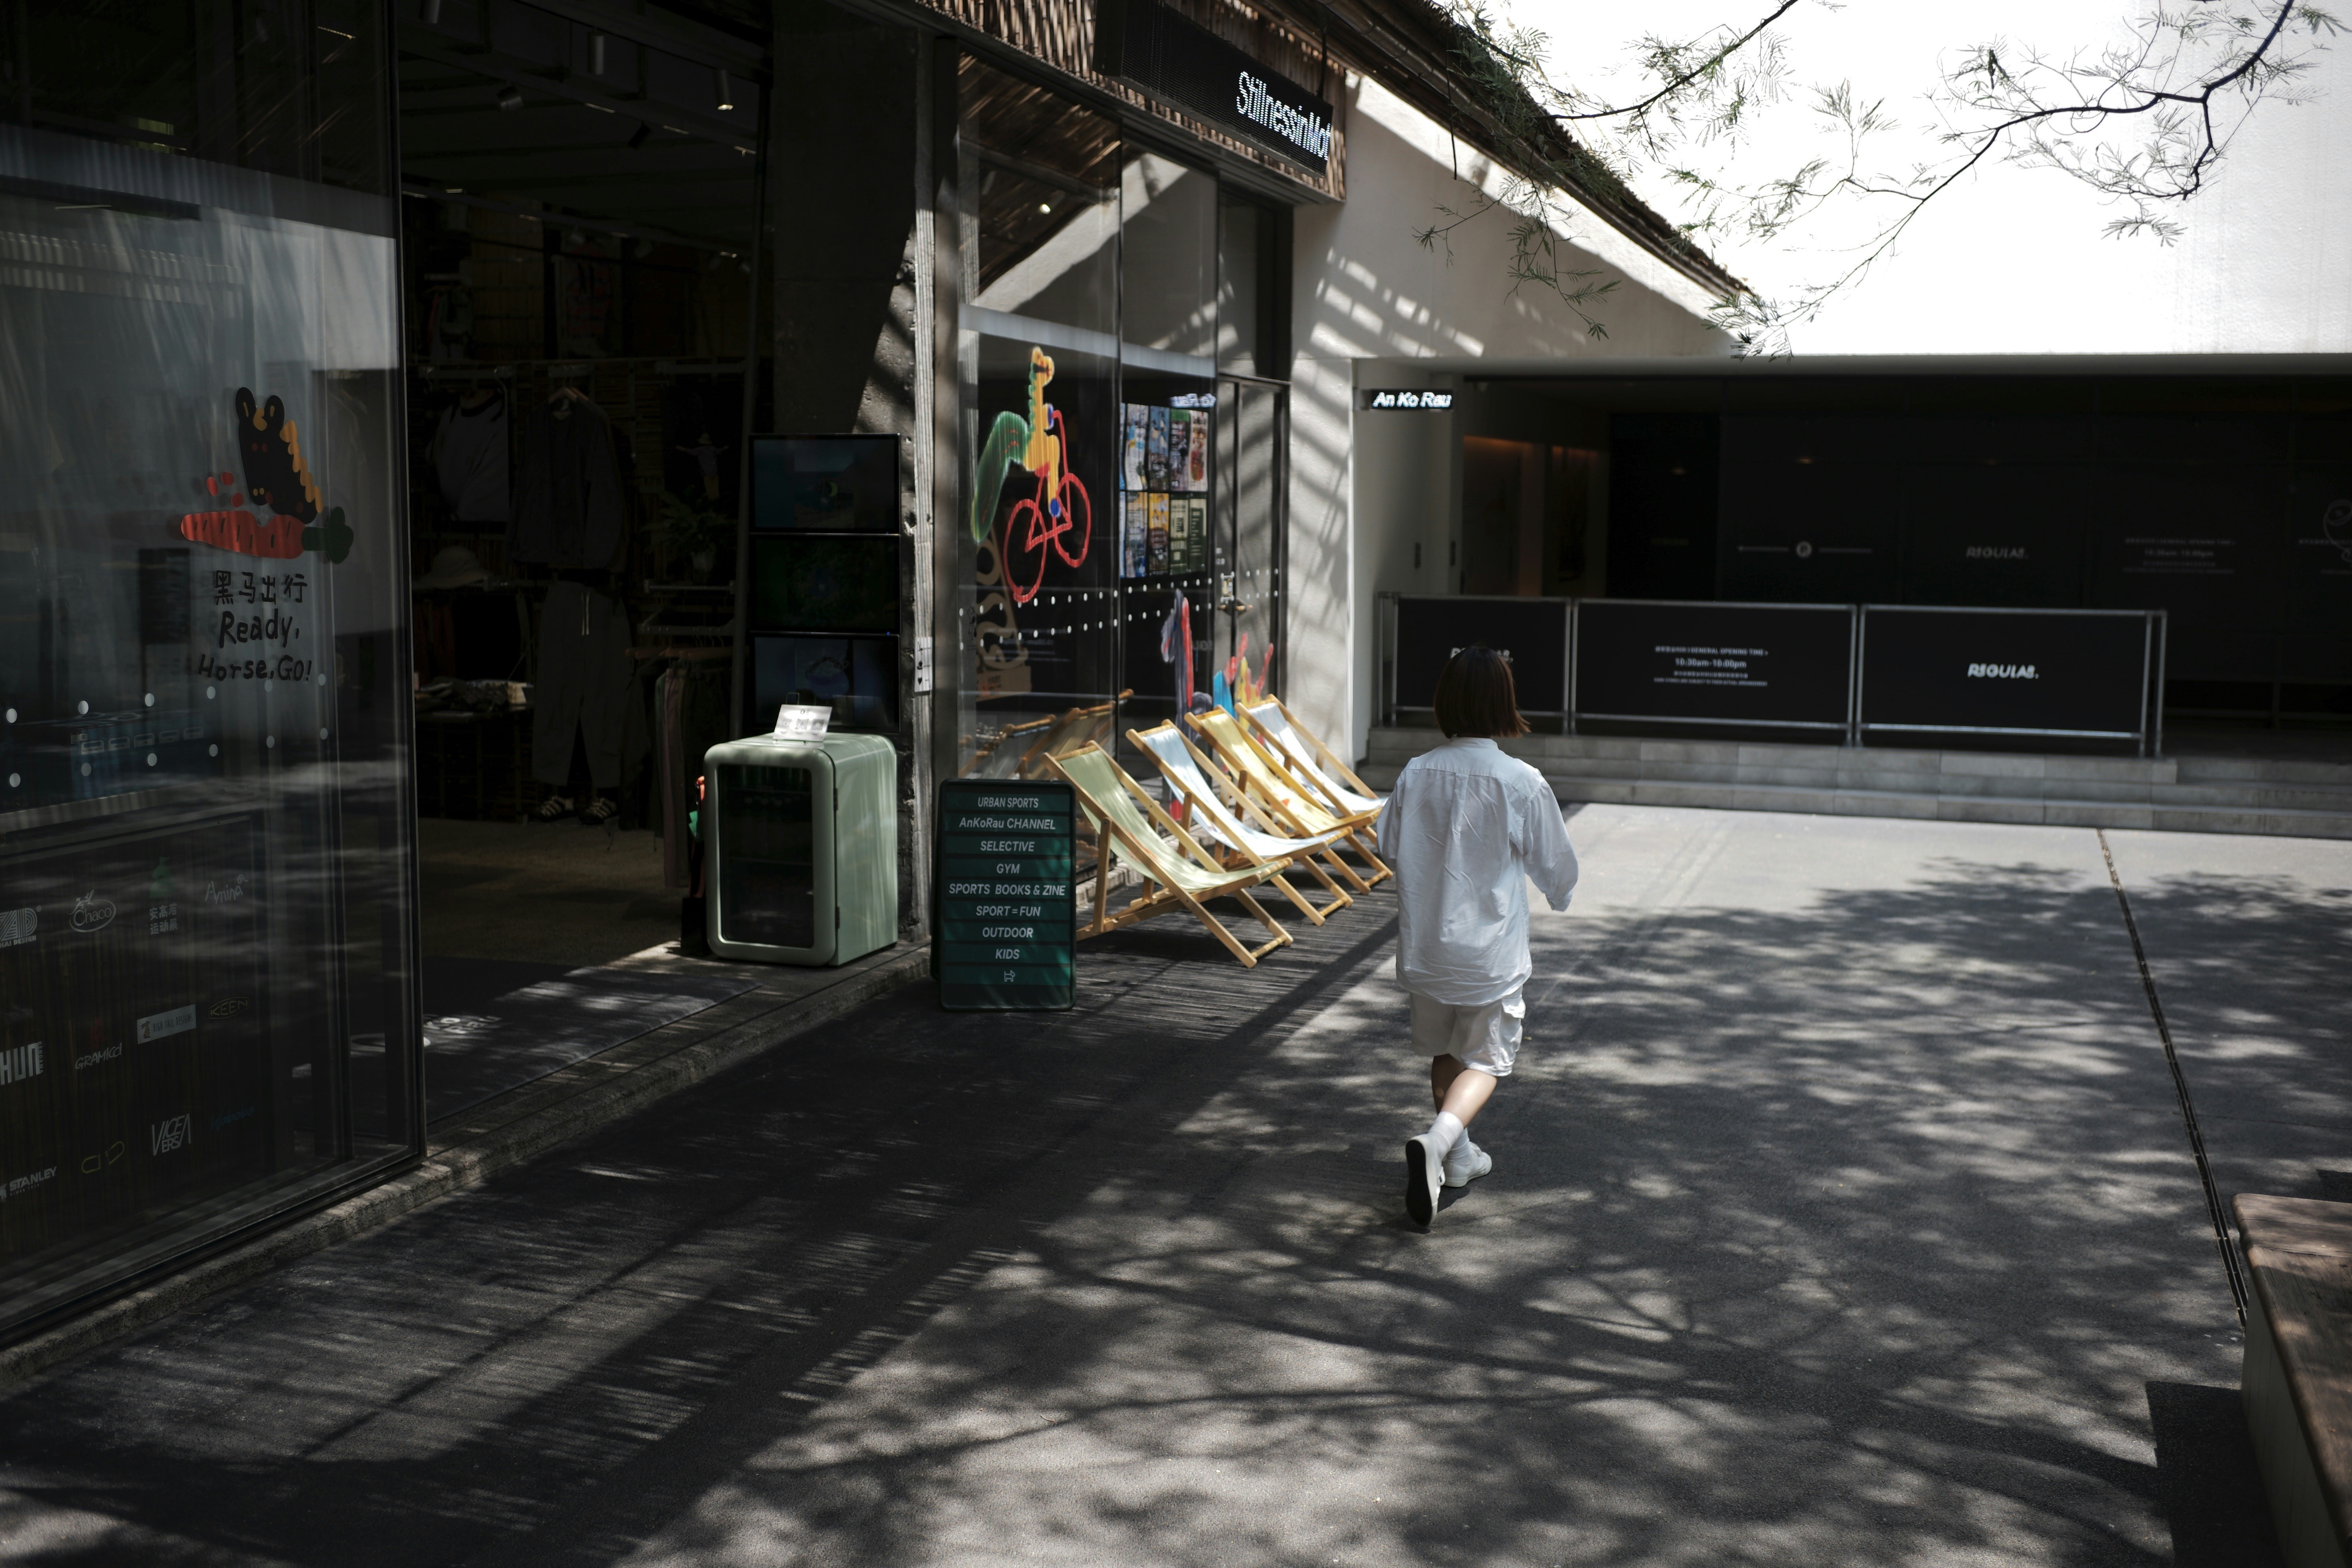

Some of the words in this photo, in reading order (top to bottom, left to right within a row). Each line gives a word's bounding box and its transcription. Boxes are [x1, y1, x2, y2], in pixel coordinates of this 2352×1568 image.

[1372, 392, 1395, 407] An
[1397, 392, 1419, 407] Ko
[1420, 392, 1452, 407] Rau
[215, 570, 307, 605] 黑马出行
[219, 609, 300, 648] Ready,
[978, 797, 1006, 808] URBAN
[1007, 797, 1038, 808] SPORTS
[959, 817, 1004, 828] AnKoRau
[1006, 818, 1056, 830] CHANNEL
[980, 841, 1035, 852] SELECTIVE
[996, 863, 1020, 874] GYM
[949, 884, 990, 894] SPORTS
[995, 884, 1031, 895] BOOKS
[1033, 886, 1040, 895] &
[1042, 885, 1066, 896] ZINE
[74, 907, 112, 926] Chaco
[150, 903, 177, 921] 安高若
[976, 906, 1011, 916] SPORT
[1020, 906, 1041, 917] FUN
[150, 918, 178, 935] 运动展
[982, 927, 1034, 938] OUTDOOR
[13, 935, 37, 945] DESIGN
[995, 948, 1020, 959] KIDS
[210, 1000, 248, 1016] KEEN
[153, 1021, 163, 1032] HIGH
[165, 1018, 174, 1029] TAIL
[176, 1014, 193, 1025] DESIGNS
[9, 1166, 57, 1191] STANLEY
[10, 1188, 25, 1196] SINCE
